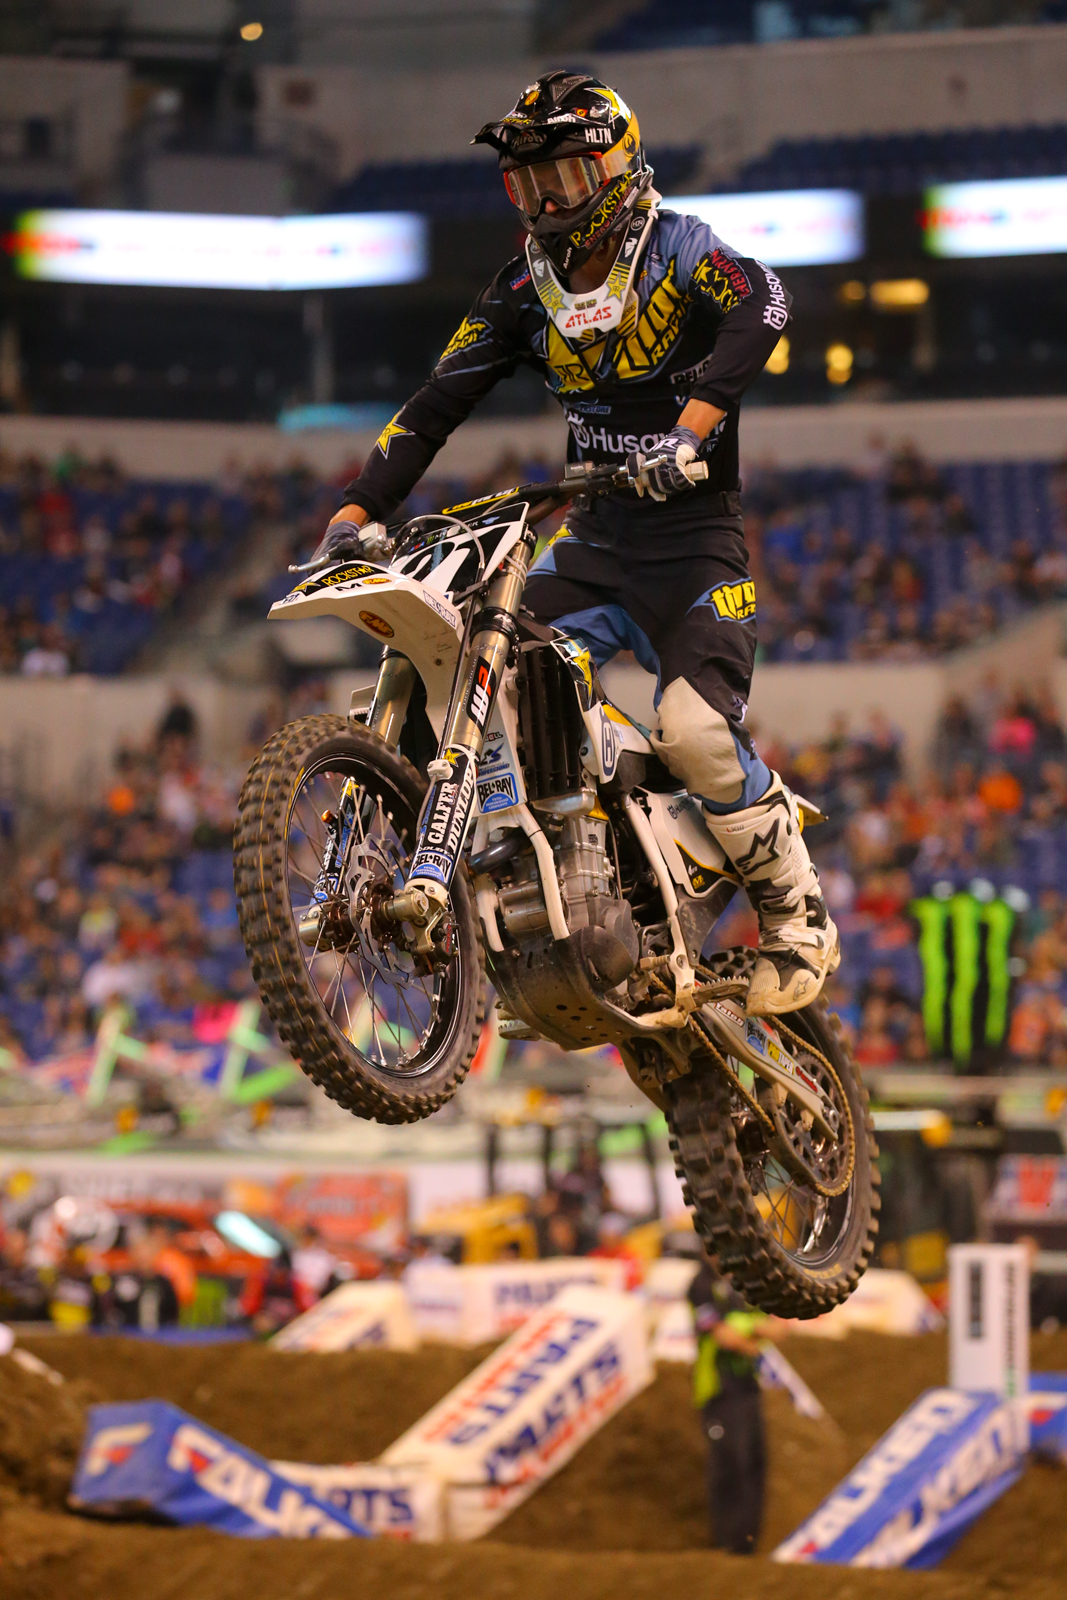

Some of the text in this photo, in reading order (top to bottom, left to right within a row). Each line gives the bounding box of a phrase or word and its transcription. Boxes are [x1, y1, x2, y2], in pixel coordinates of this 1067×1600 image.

[584, 127, 613, 144] HLTN
[565, 305, 612, 328] ATLAS
[321, 564, 374, 587] ROCKSTAR
[360, 612, 395, 637] FMF
[427, 782, 457, 845] GALFER
[446, 765, 474, 852] DUNLOP
